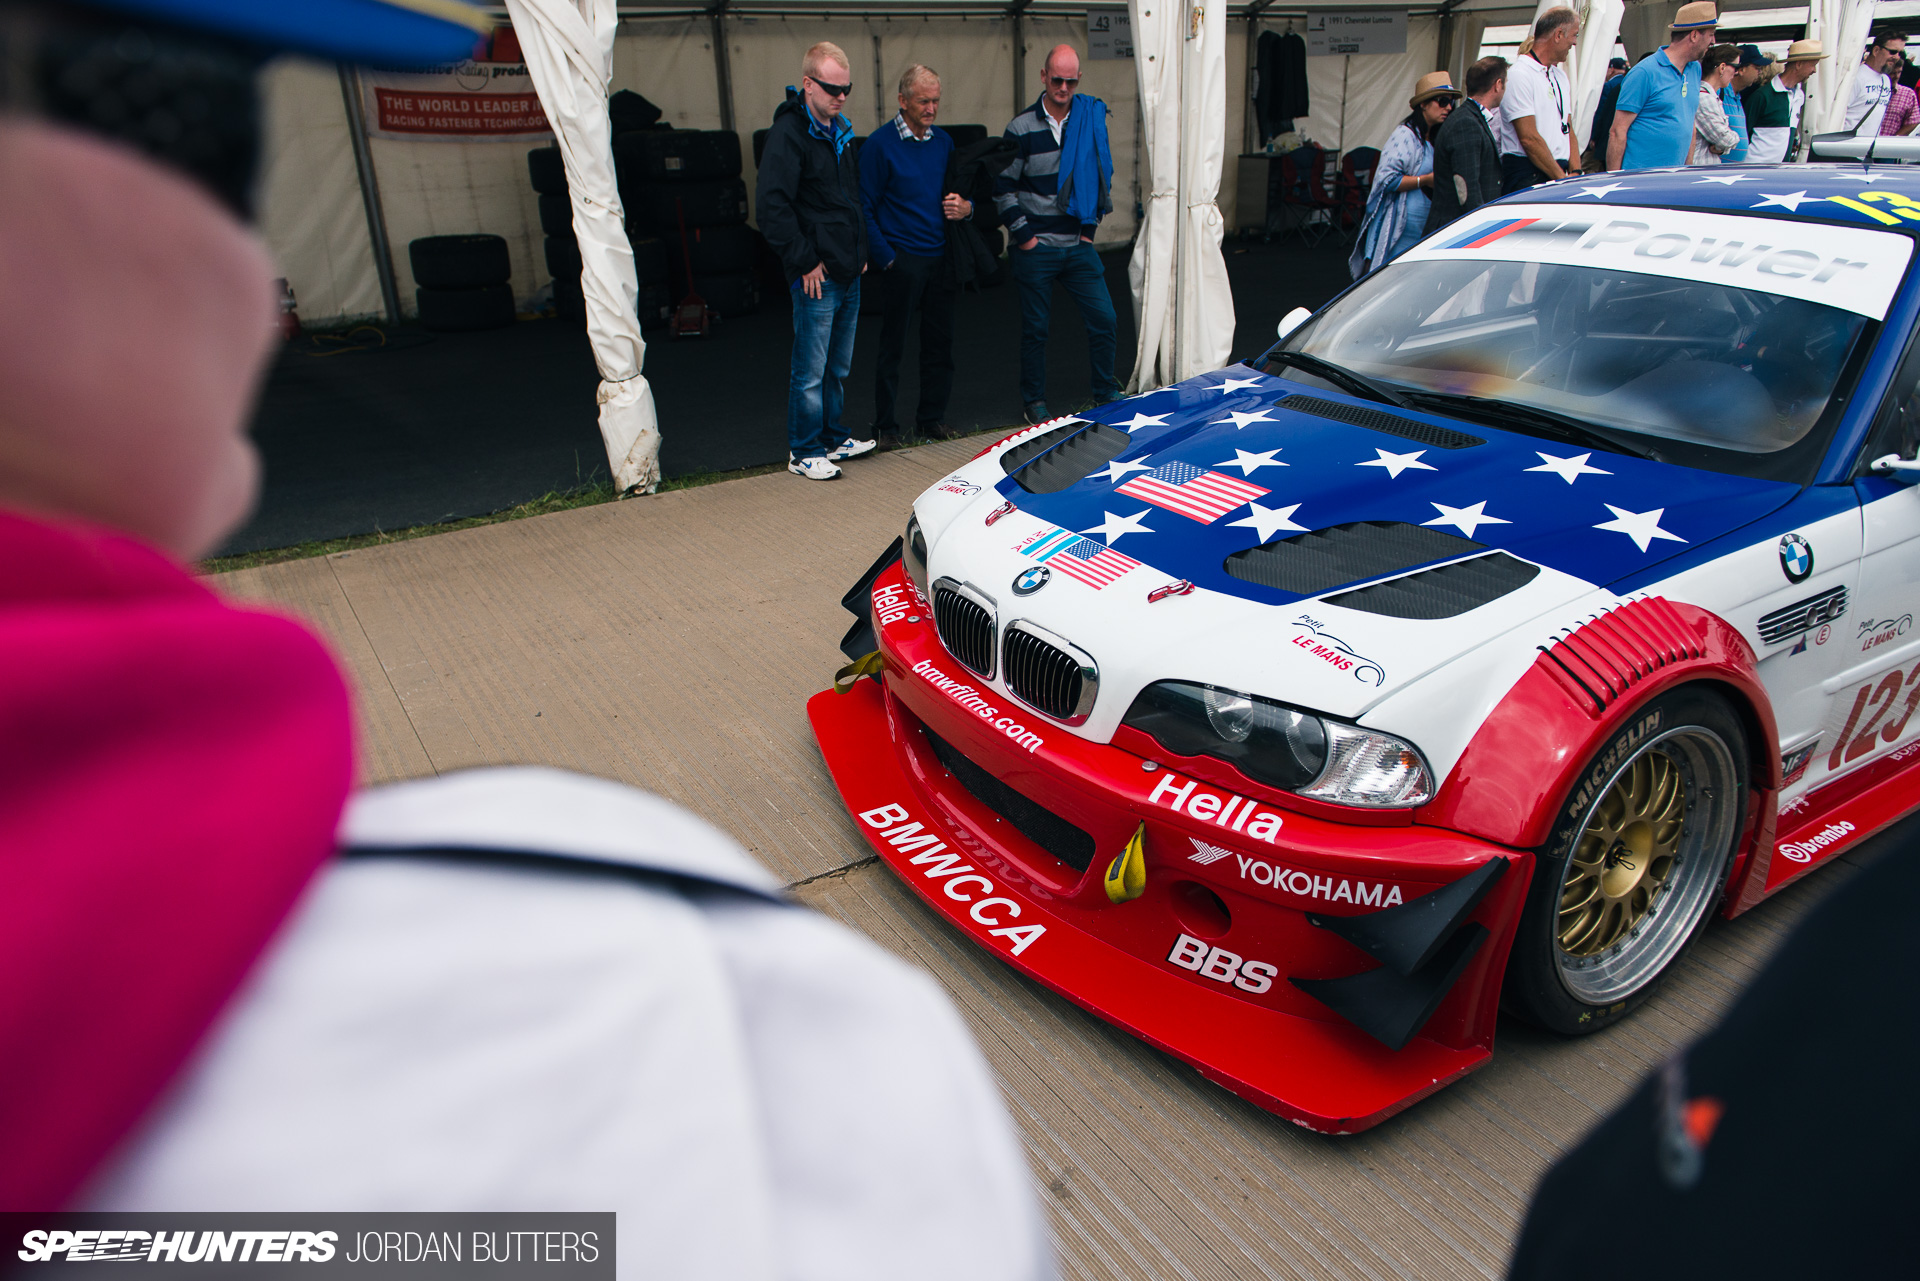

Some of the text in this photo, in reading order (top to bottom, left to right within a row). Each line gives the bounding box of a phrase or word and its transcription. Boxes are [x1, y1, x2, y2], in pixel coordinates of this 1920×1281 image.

[1096, 16, 1110, 29] 43
[1319, 17, 1325, 28] 4
[1345, 16, 1371, 24] Chevrolet
[384, 96, 413, 111] THE
[418, 98, 470, 113] WORLD
[474, 100, 529, 114] LEADER
[386, 113, 548, 129] RACING FASTENER TECHNOLOGY
[1580, 219, 1870, 284] Power
[872, 583, 911, 626] Hella
[1298, 614, 1325, 629] Petit
[1858, 618, 1875, 631] Petit
[1861, 627, 1898, 652] LE MANS
[1292, 635, 1353, 671] LE MANS
[911, 658, 1044, 754] bmwfilms.com
[1568, 710, 1661, 819] MICHELIN
[1148, 773, 1284, 844] Hella
[1794, 820, 1856, 855] brembo
[858, 802, 1047, 957] BMWCCA
[1236, 854, 1403, 908] YOKOHAMA
[1165, 933, 1279, 994] BBS
